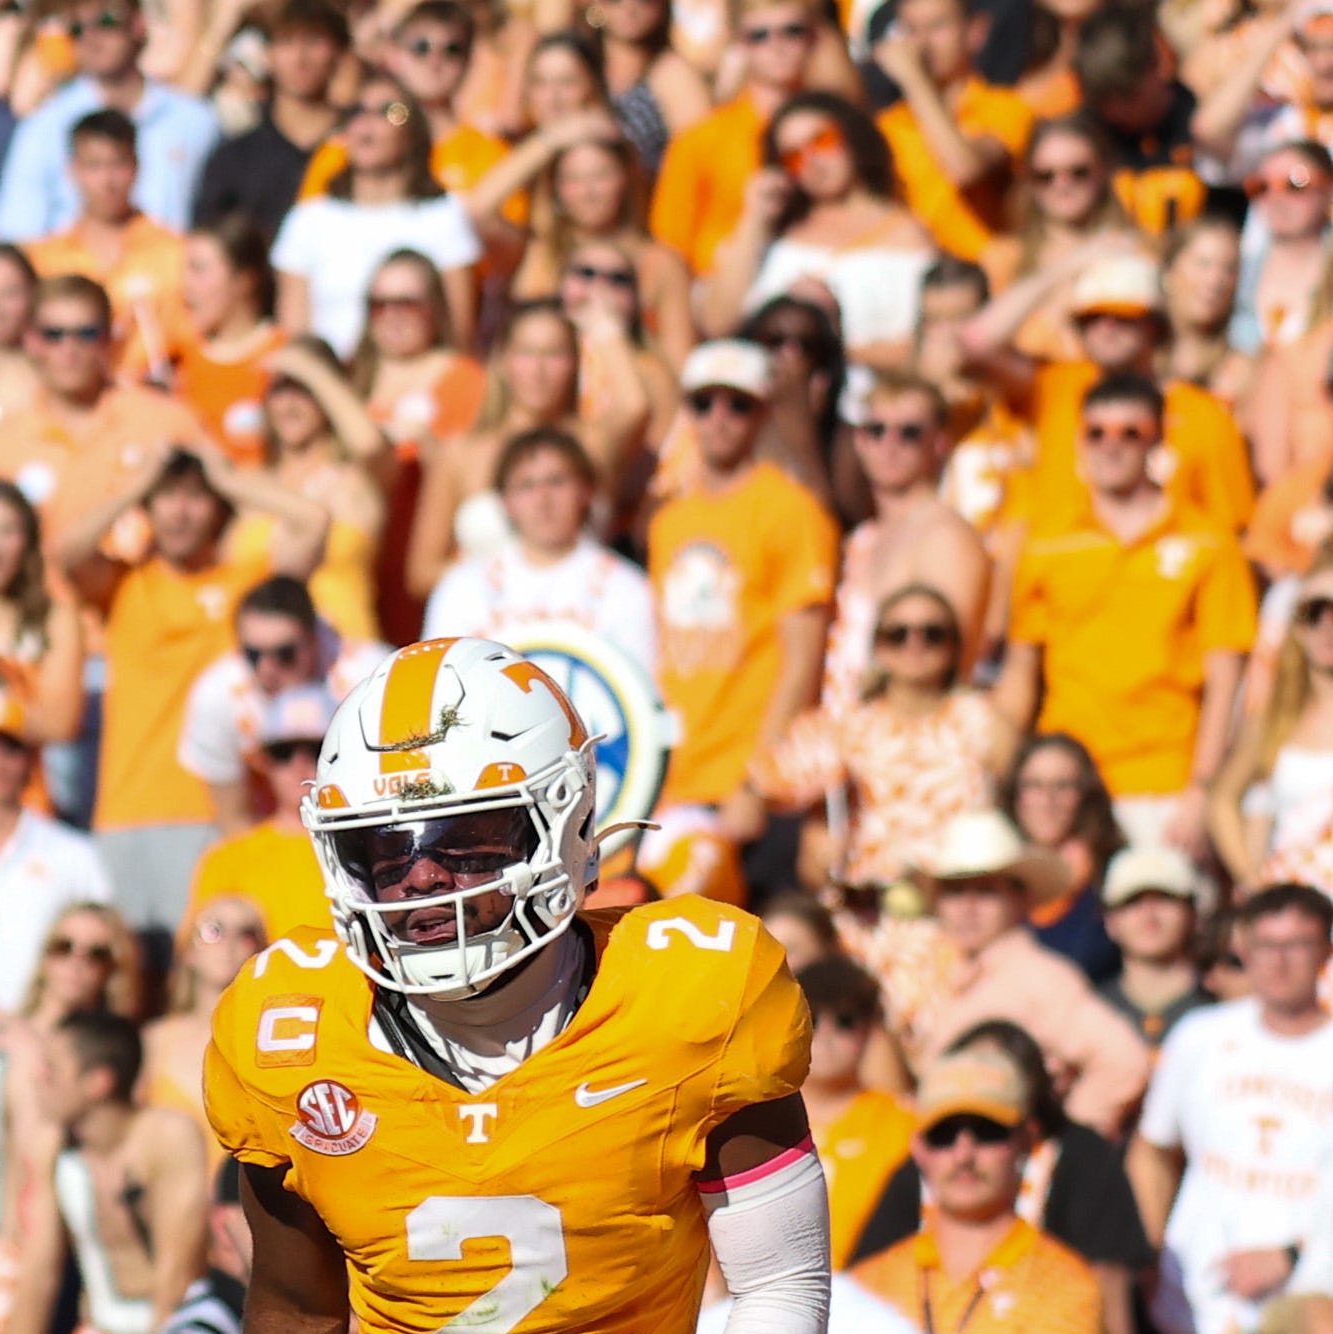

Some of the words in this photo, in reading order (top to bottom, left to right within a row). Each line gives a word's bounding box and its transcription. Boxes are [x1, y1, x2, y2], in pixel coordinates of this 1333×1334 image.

[646, 916, 736, 953] 2
[258, 1006, 318, 1051] C
[299, 1083, 359, 1137] SEC
[458, 1103, 498, 1143] T
